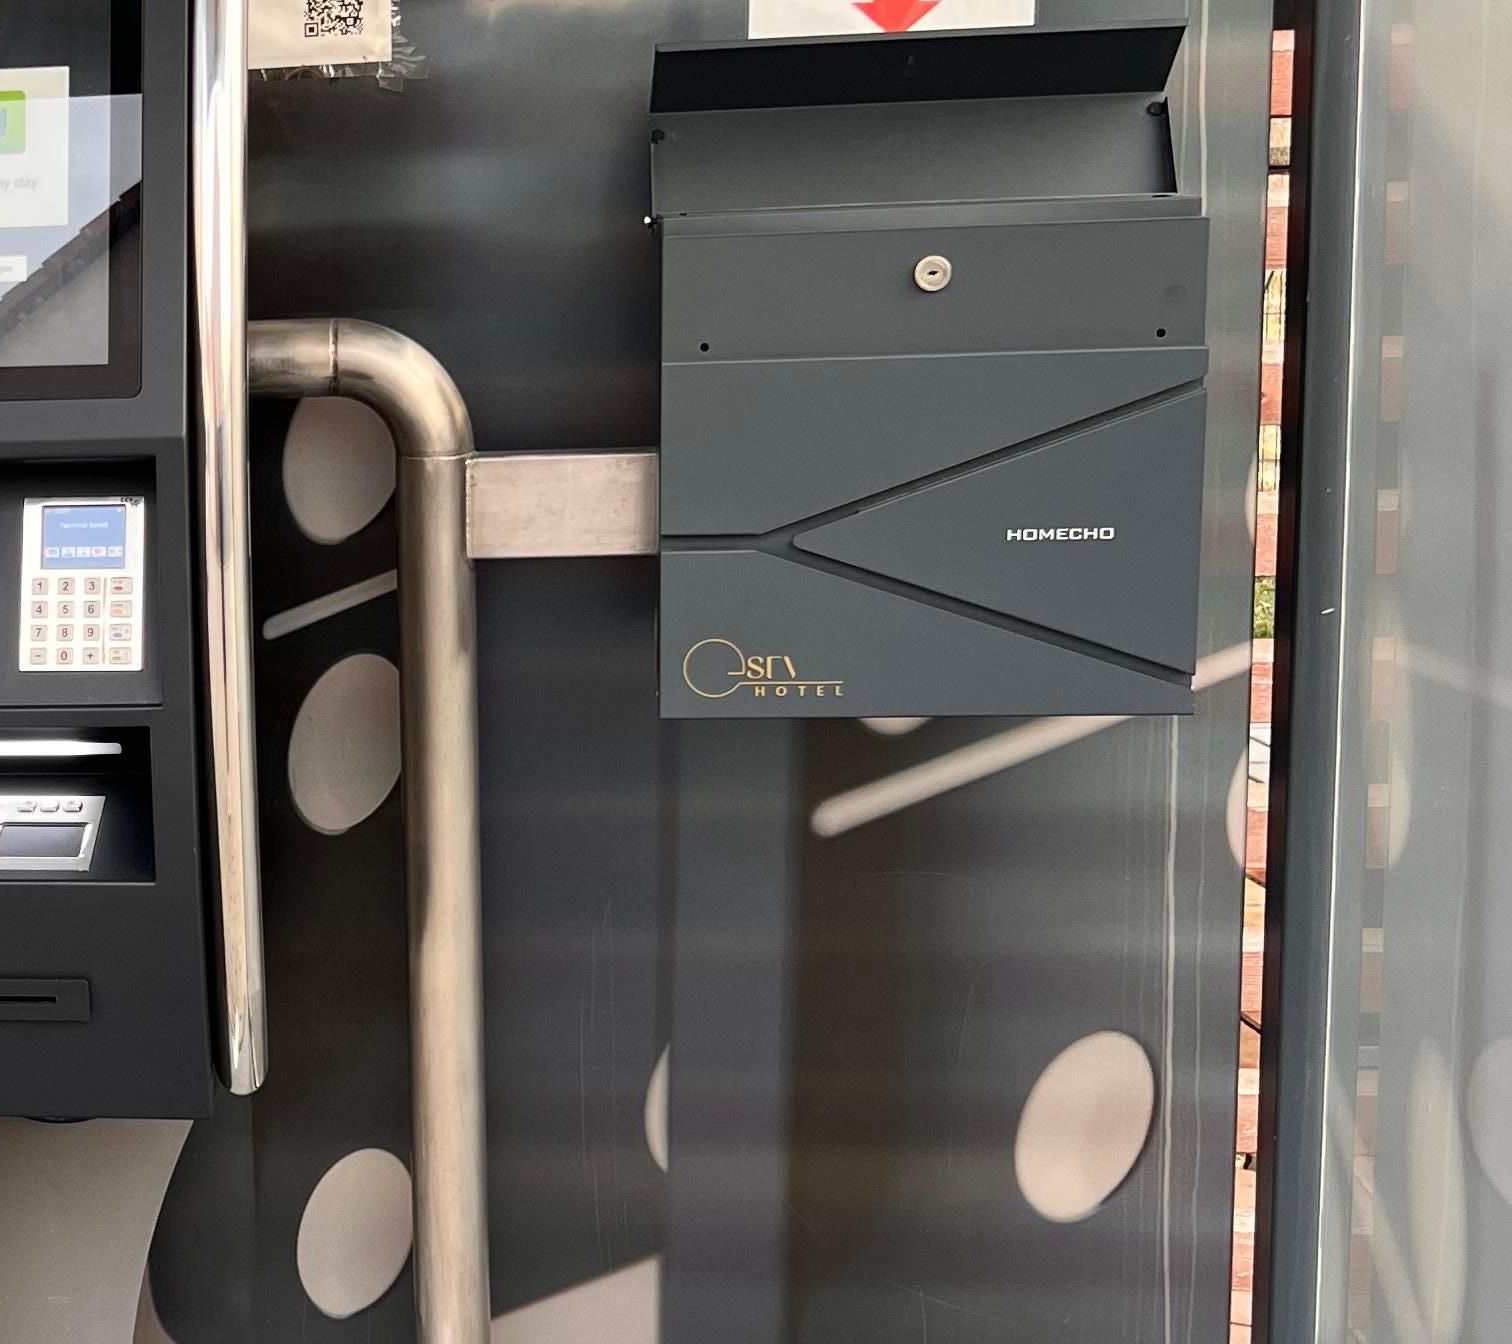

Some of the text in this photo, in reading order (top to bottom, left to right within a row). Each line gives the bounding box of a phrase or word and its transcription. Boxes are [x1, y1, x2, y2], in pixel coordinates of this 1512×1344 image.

[13, 177, 38, 191] stay
[1007, 527, 1115, 541] HOMECHO
[63, 581, 69, 591] 2
[89, 581, 95, 591] 3
[36, 605, 94, 614] 4 5 6
[36, 628, 94, 637] 7 8 9
[61, 651, 68, 660] 0
[755, 685, 844, 697] HOTEL
